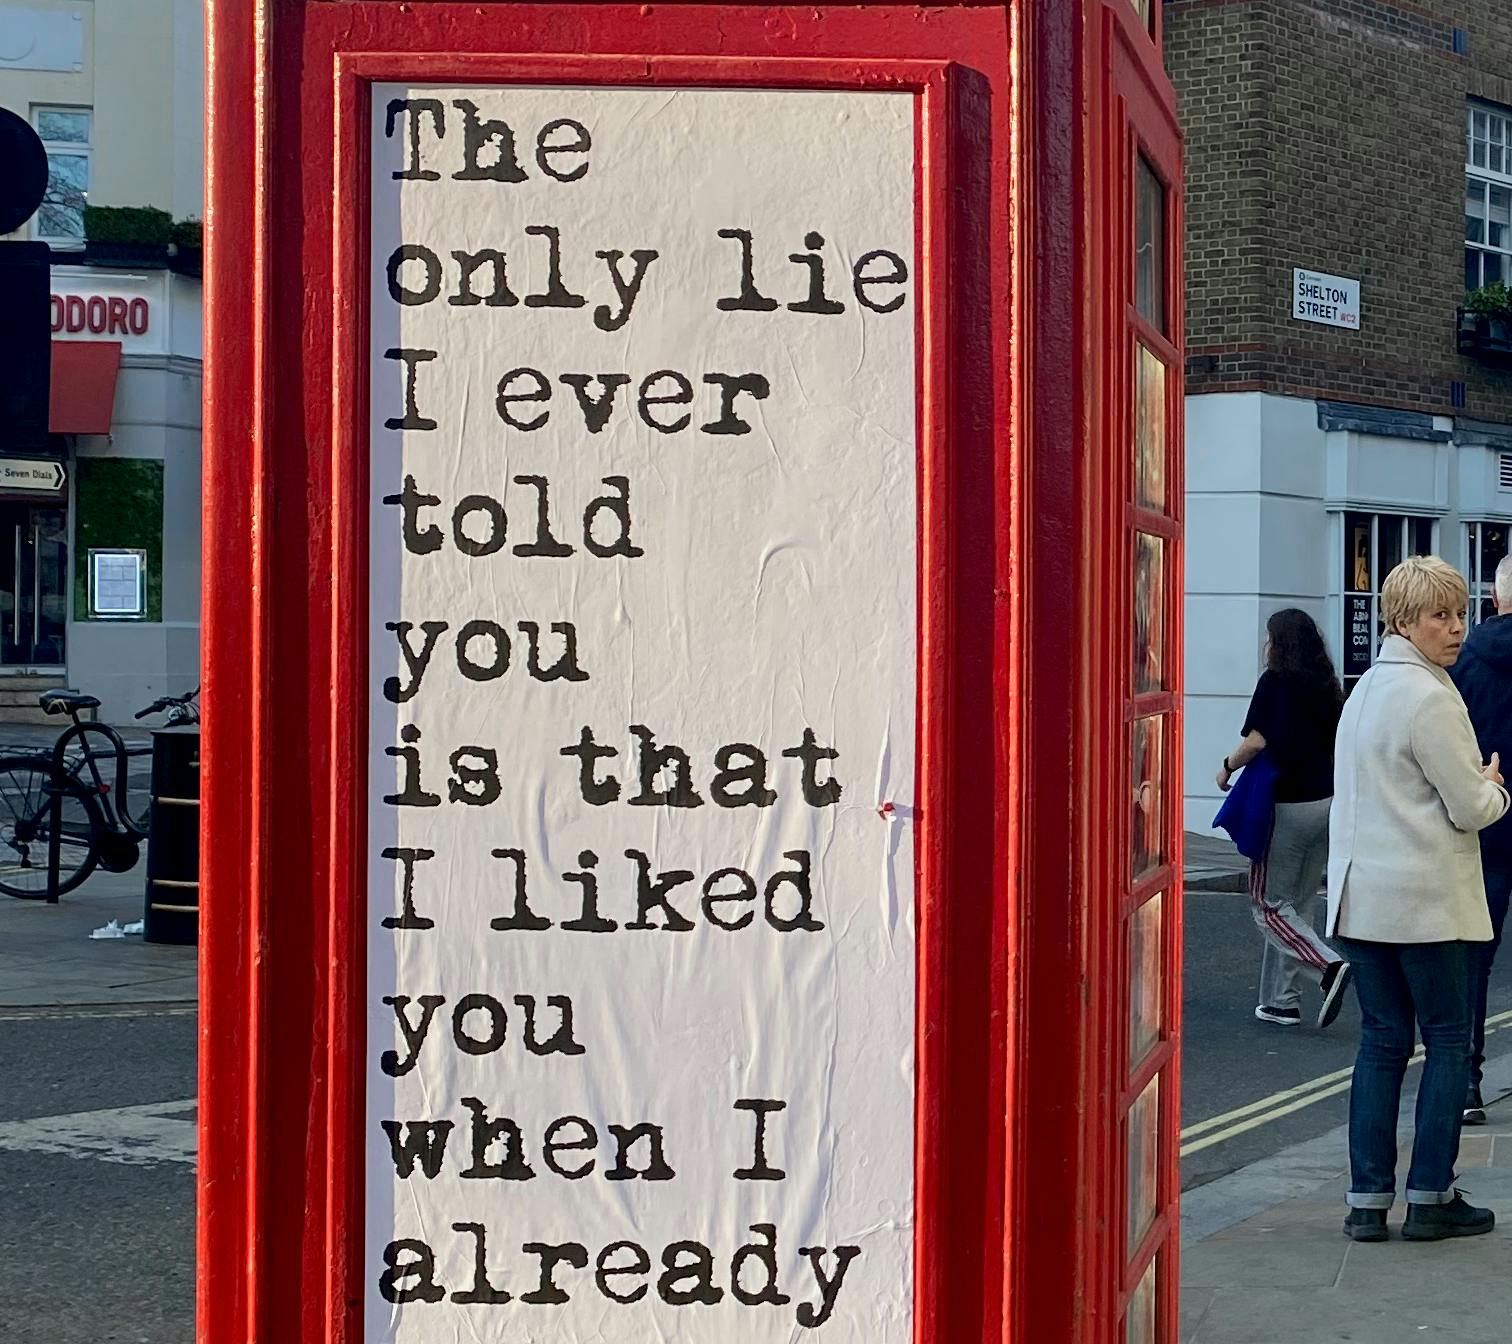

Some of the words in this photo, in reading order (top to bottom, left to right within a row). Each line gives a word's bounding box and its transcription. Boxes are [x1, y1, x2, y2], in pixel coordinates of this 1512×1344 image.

[382, 97, 592, 184] The
[384, 224, 661, 334] only
[715, 227, 909, 316] lie
[1299, 283, 1347, 304] SHELTON
[1299, 301, 1338, 320] STREET
[1340, 312, 1356, 323] WC2
[383, 347, 439, 432] I
[495, 366, 771, 437] ever
[5, 468, 30, 478] Seven
[33, 469, 52, 479] Dials
[382, 473, 645, 560] told
[1353, 599, 1366, 610] THE
[382, 618, 591, 705] you
[382, 722, 504, 809] is
[558, 723, 844, 810] that
[379, 846, 436, 931] I
[489, 847, 826, 935] liked
[379, 992, 587, 1079] you
[379, 1096, 677, 1183] when
[732, 1097, 788, 1182] I
[377, 1220, 863, 1330] already
